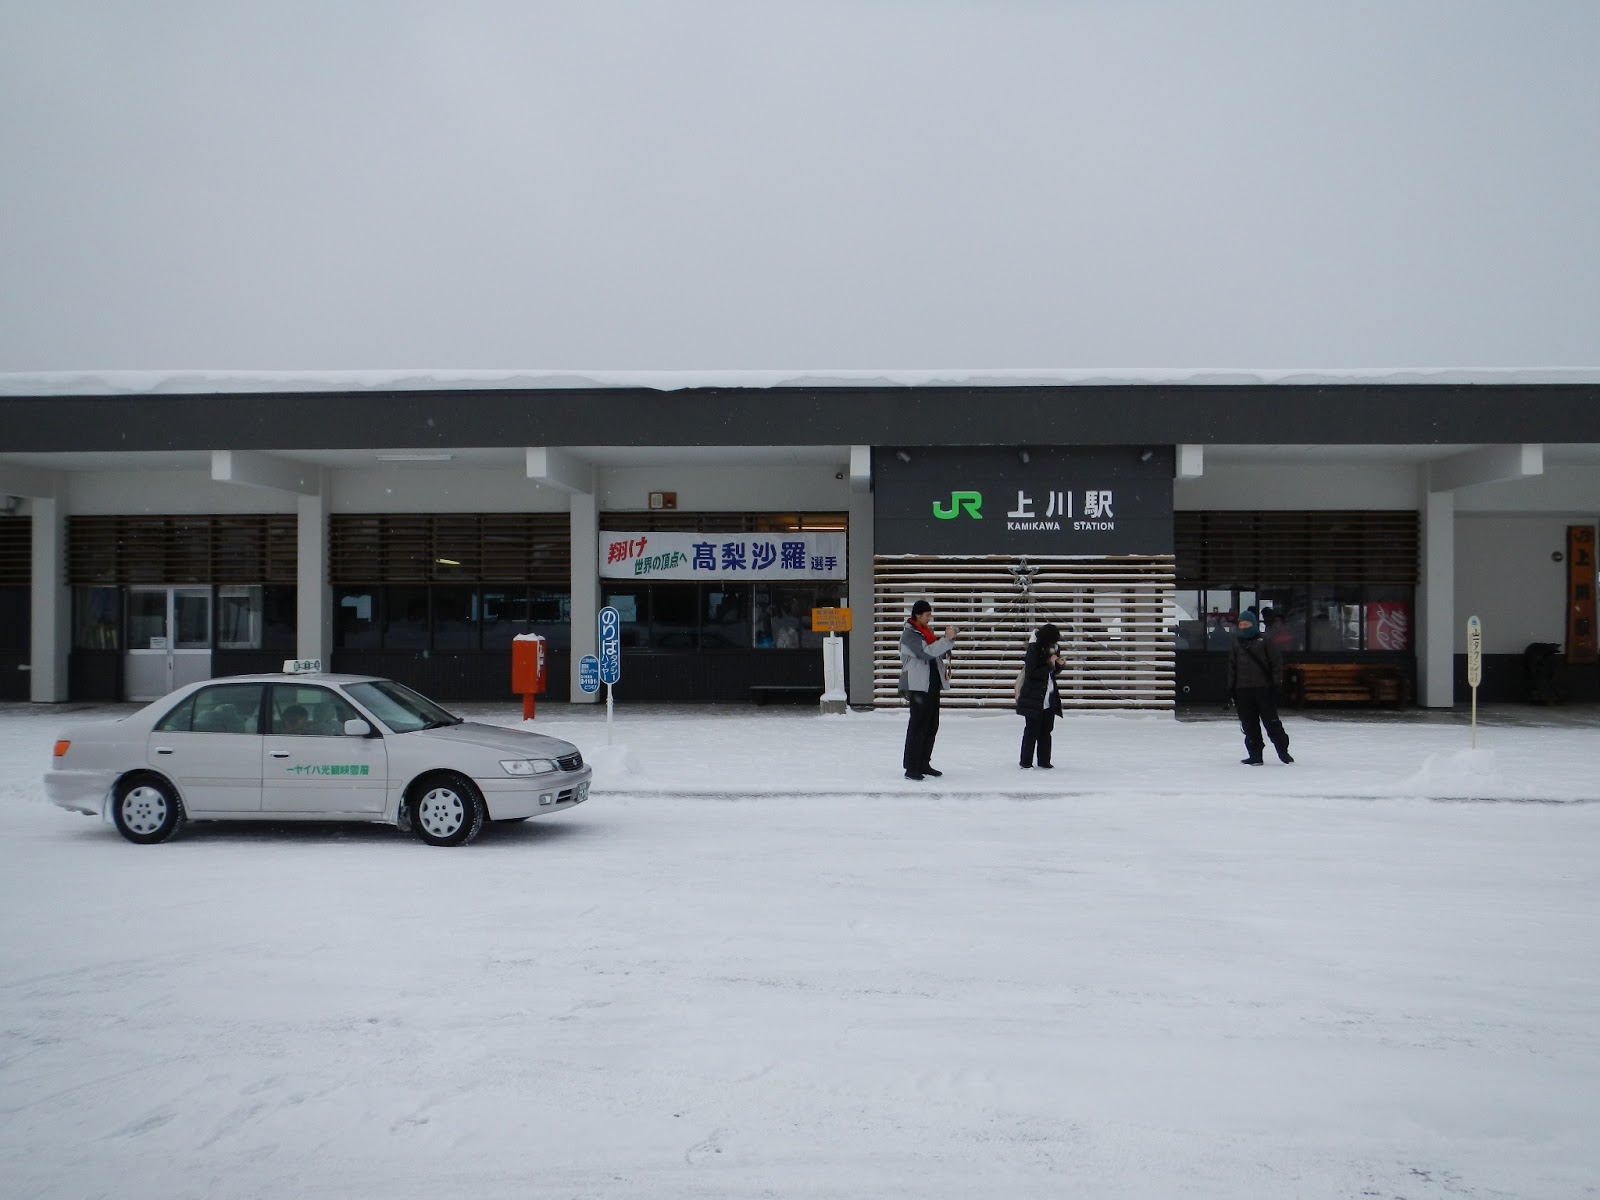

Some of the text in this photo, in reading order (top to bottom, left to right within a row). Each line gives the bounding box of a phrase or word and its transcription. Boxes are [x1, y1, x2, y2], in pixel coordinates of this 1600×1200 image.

[932, 490, 983, 520] JR
[1007, 490, 1114, 519] 上川駅
[1007, 521, 1115, 531] KAMIKAWA STATION
[607, 536, 649, 565] 翔け
[634, 550, 688, 576] 世界の頂点へ
[811, 556, 838, 571] 選手
[602, 610, 618, 656] のりば
[601, 655, 610, 681] ハイヤー
[610, 655, 618, 682] タクシー
